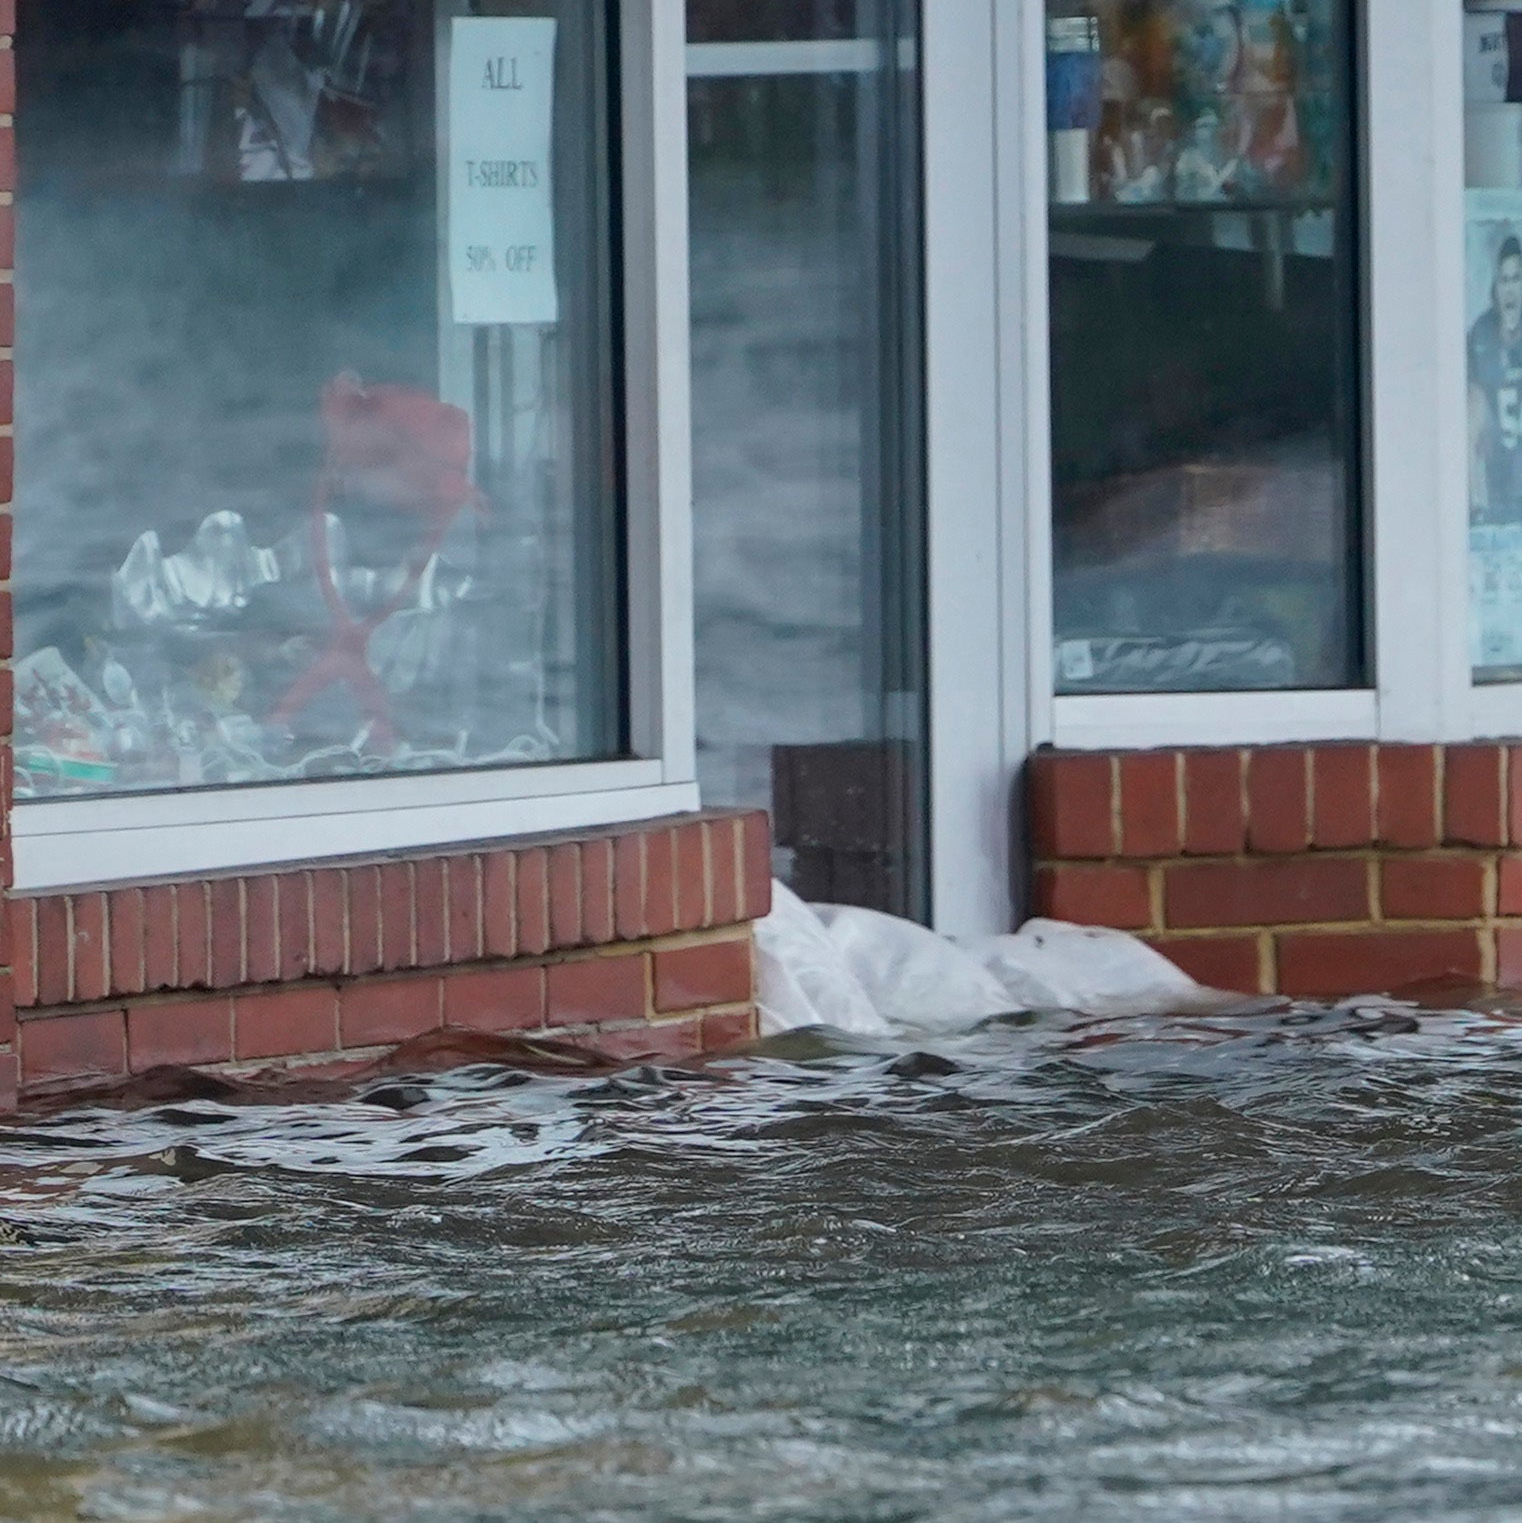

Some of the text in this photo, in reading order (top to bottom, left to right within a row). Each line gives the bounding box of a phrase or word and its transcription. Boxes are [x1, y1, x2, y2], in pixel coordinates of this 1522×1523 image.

[481, 56, 523, 91] ALL
[465, 160, 539, 189] T-SHIRTS
[465, 245, 537, 273] 50% OFF
